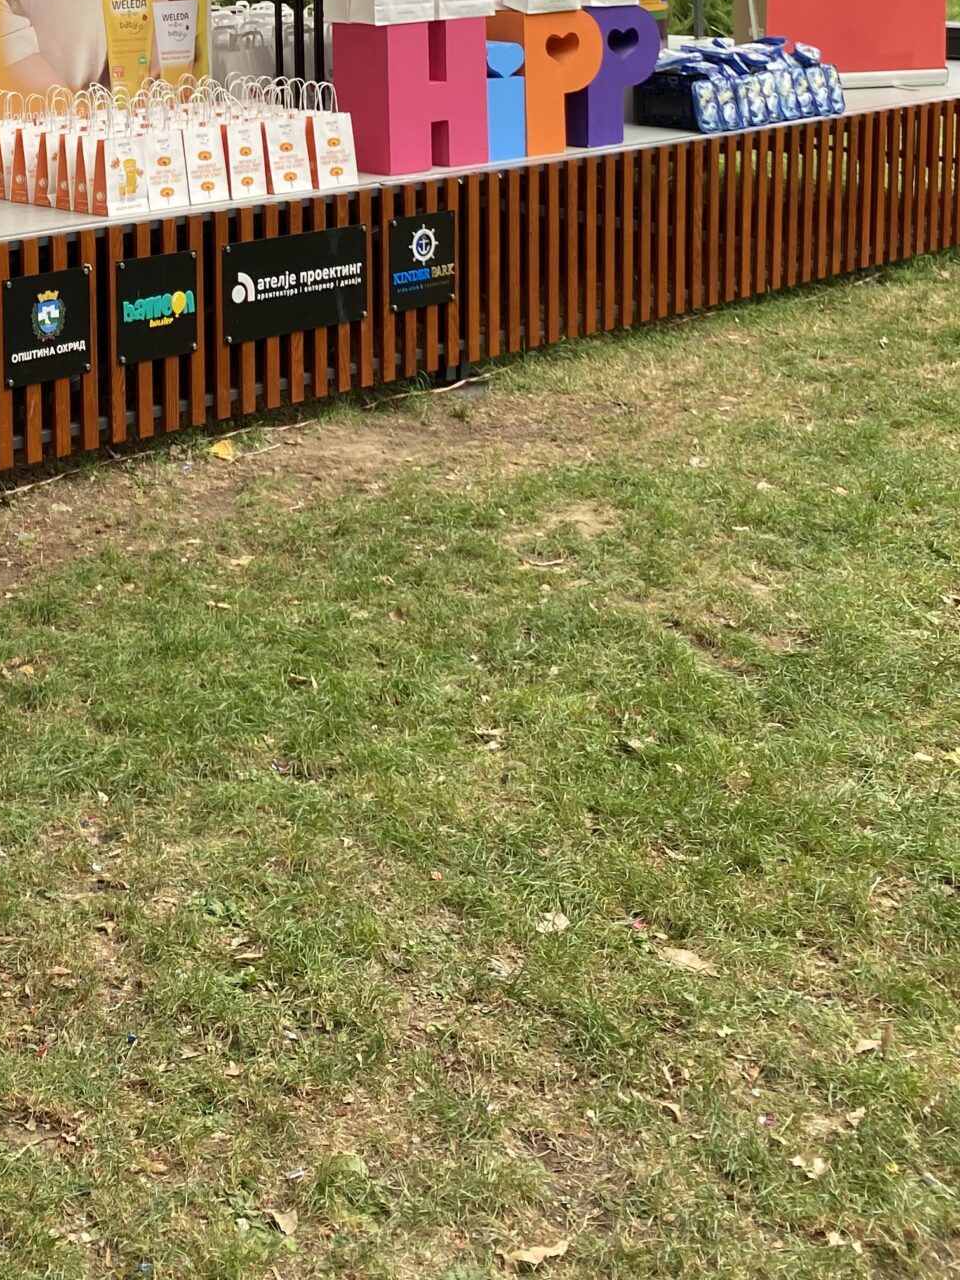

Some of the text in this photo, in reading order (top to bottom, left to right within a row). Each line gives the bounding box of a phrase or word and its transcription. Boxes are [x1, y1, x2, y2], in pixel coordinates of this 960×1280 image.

[112, 0, 147, 10] WELEDA
[162, 12, 189, 22] WELEDA
[257, 262, 362, 291] ателје проектинг
[393, 267, 431, 285] KINDER
[11, 339, 86, 364] ОПШТИНА ОХРИД
